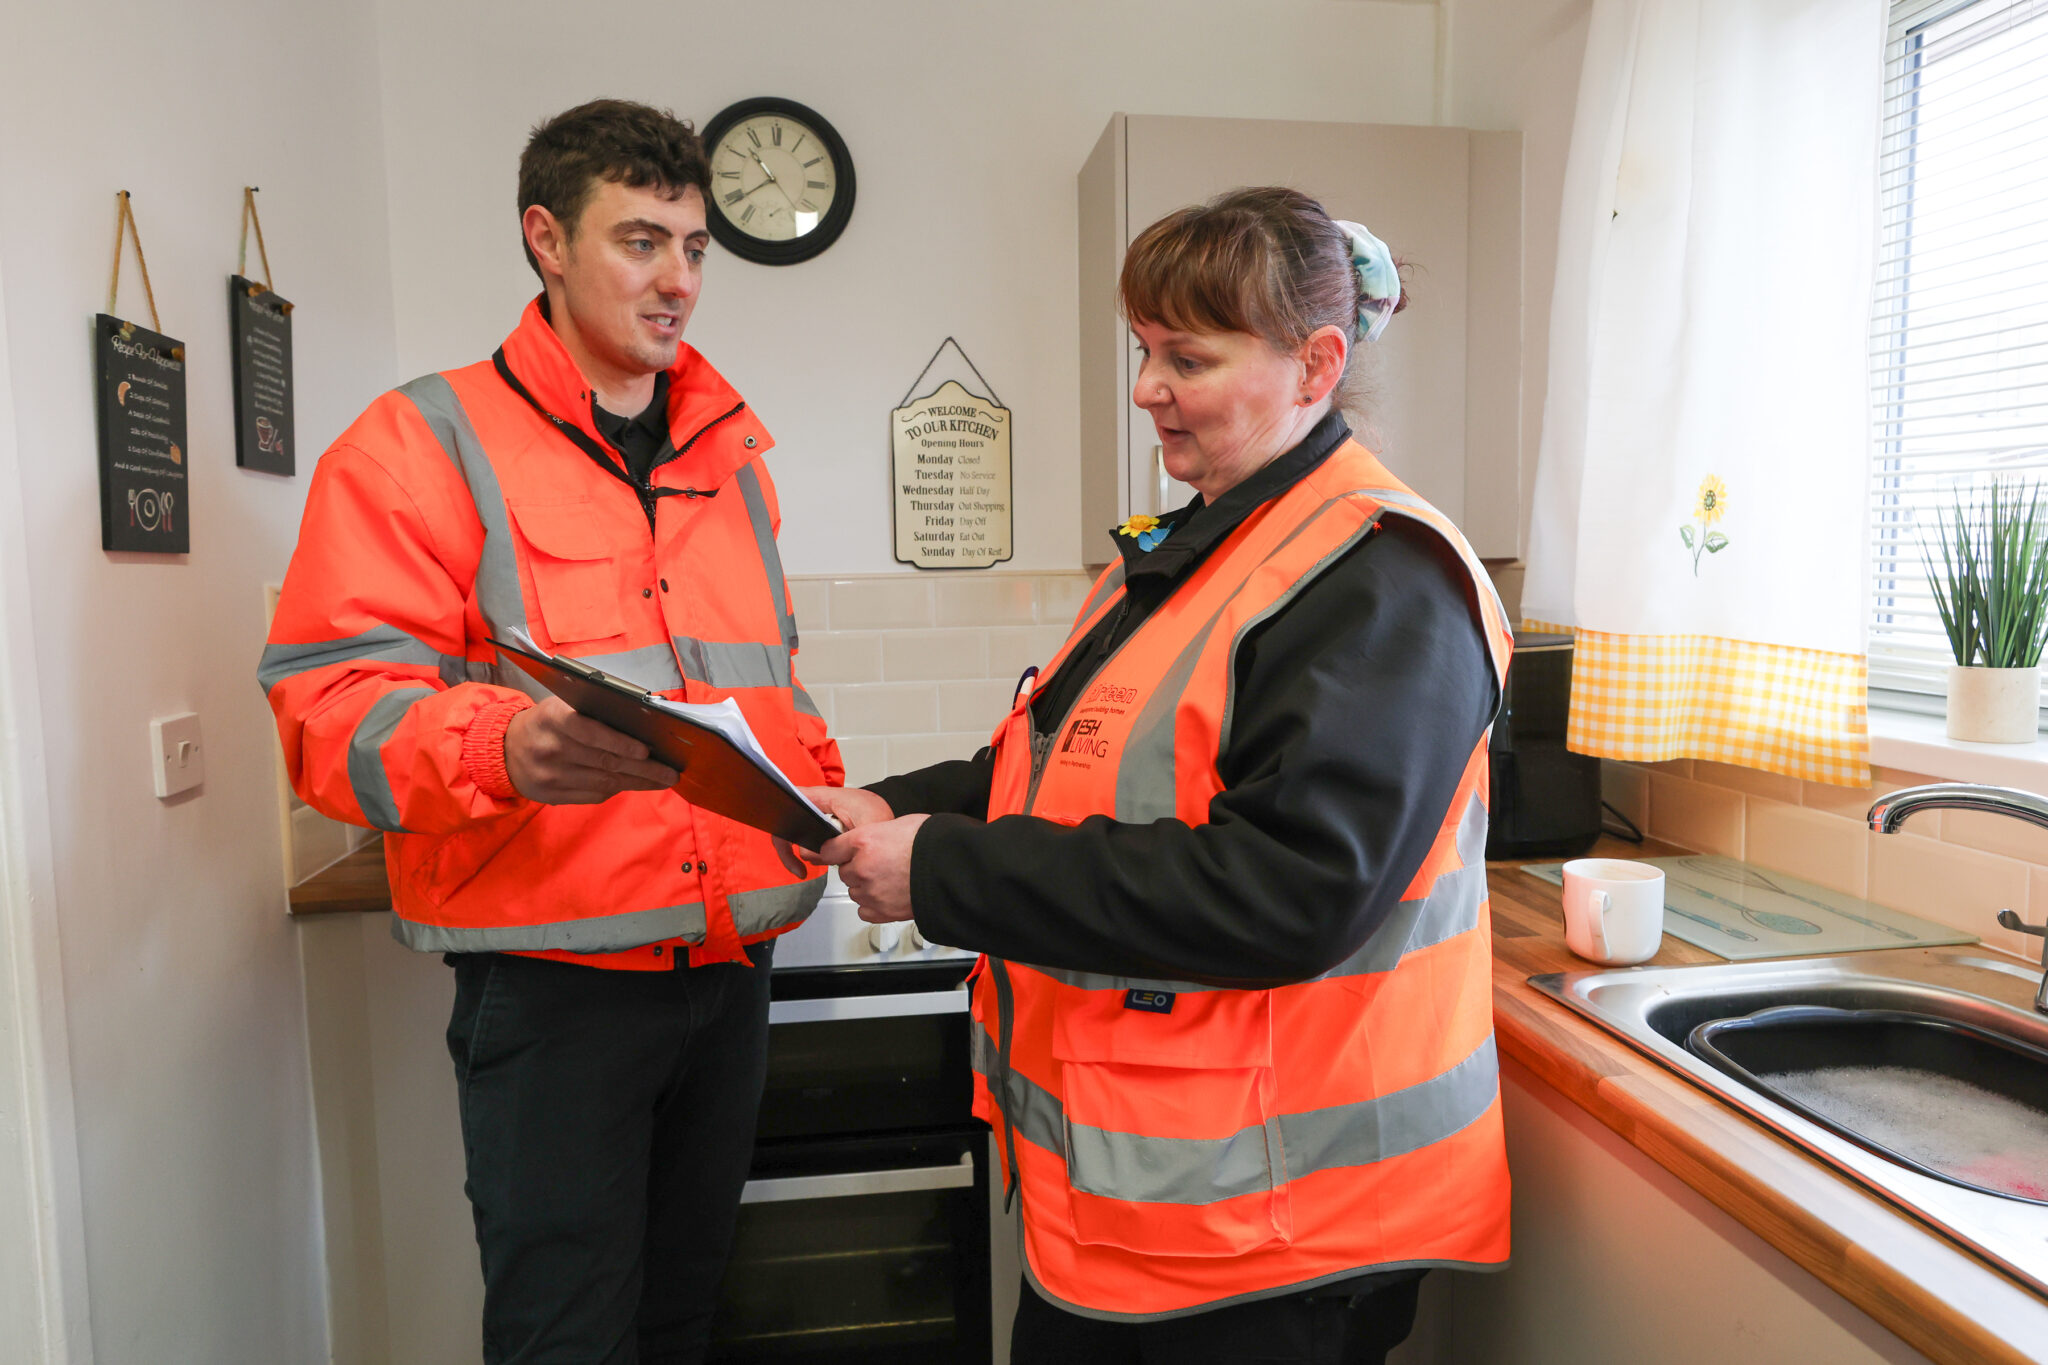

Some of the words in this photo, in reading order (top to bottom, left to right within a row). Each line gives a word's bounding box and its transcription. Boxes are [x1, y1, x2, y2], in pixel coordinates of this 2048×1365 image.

[927, 405, 977, 418] WELCOME
[905, 425, 921, 440] TO
[923, 419, 948, 434] OUR
[950, 419, 1000, 441] KITCHEN
[921, 438, 957, 449] Opening
[959, 439, 984, 448] Hours
[917, 453, 954, 465] Monday
[957, 455, 981, 465] Closed
[914, 469, 954, 481] Tuesday
[960, 471, 970, 479] No
[970, 471, 996, 480] Service
[902, 485, 954, 496] Wednesday
[960, 486, 975, 495] Half
[976, 486, 990, 497] Day
[910, 500, 955, 512] Thursday
[958, 502, 972, 511] Out
[973, 502, 1006, 513] Shopping
[925, 515, 955, 527] Friday
[960, 516, 973, 528] Day
[974, 516, 987, 526] Off
[913, 531, 955, 543] Saturday
[959, 532, 970, 541] Eat
[971, 532, 985, 541] Out
[921, 546, 955, 558] Sunday
[962, 547, 976, 558] Day
[988, 547, 1002, 556] Rest
[1077, 719, 1103, 737] ESH
[1069, 737, 1109, 758] LIVING
